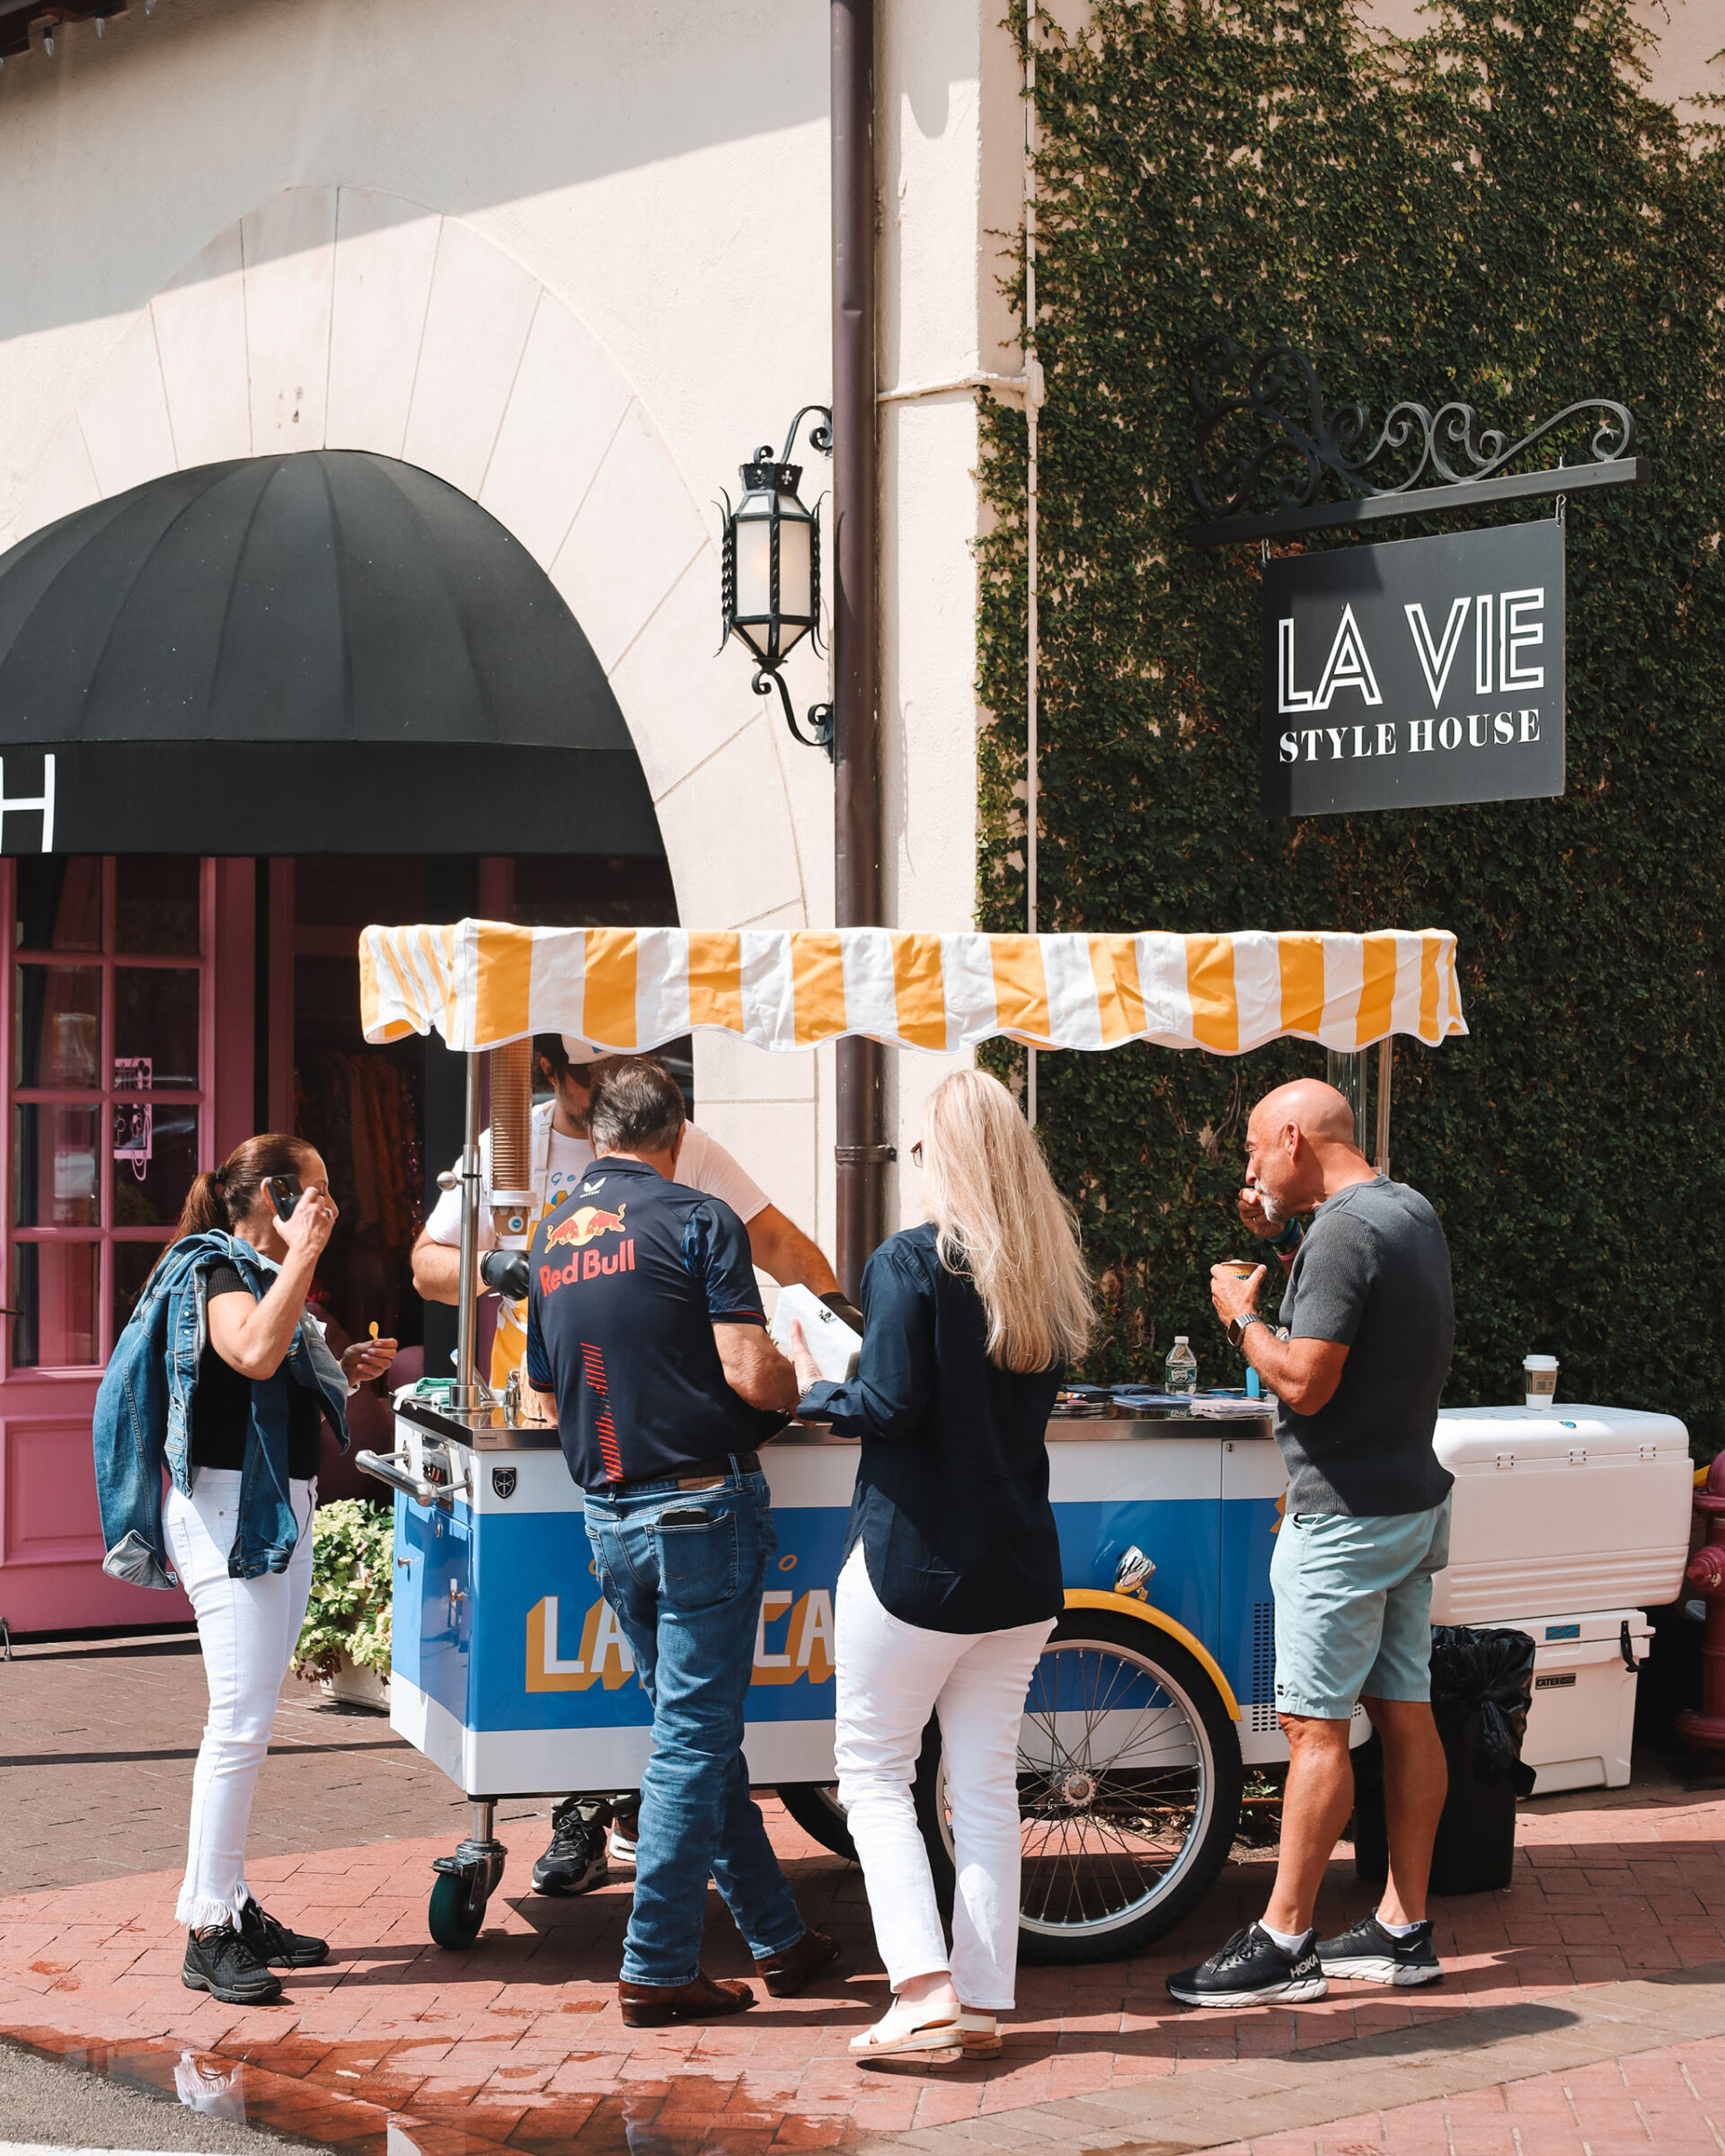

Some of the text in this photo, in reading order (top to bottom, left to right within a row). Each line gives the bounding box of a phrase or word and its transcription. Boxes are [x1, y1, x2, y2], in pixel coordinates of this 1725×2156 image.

[1278, 587, 1544, 713] LA VIE
[1278, 708, 1541, 763] STYLE HOUSE
[539, 1238, 635, 1298] Red Bull
[1289, 1953, 1320, 1978] HOKA
